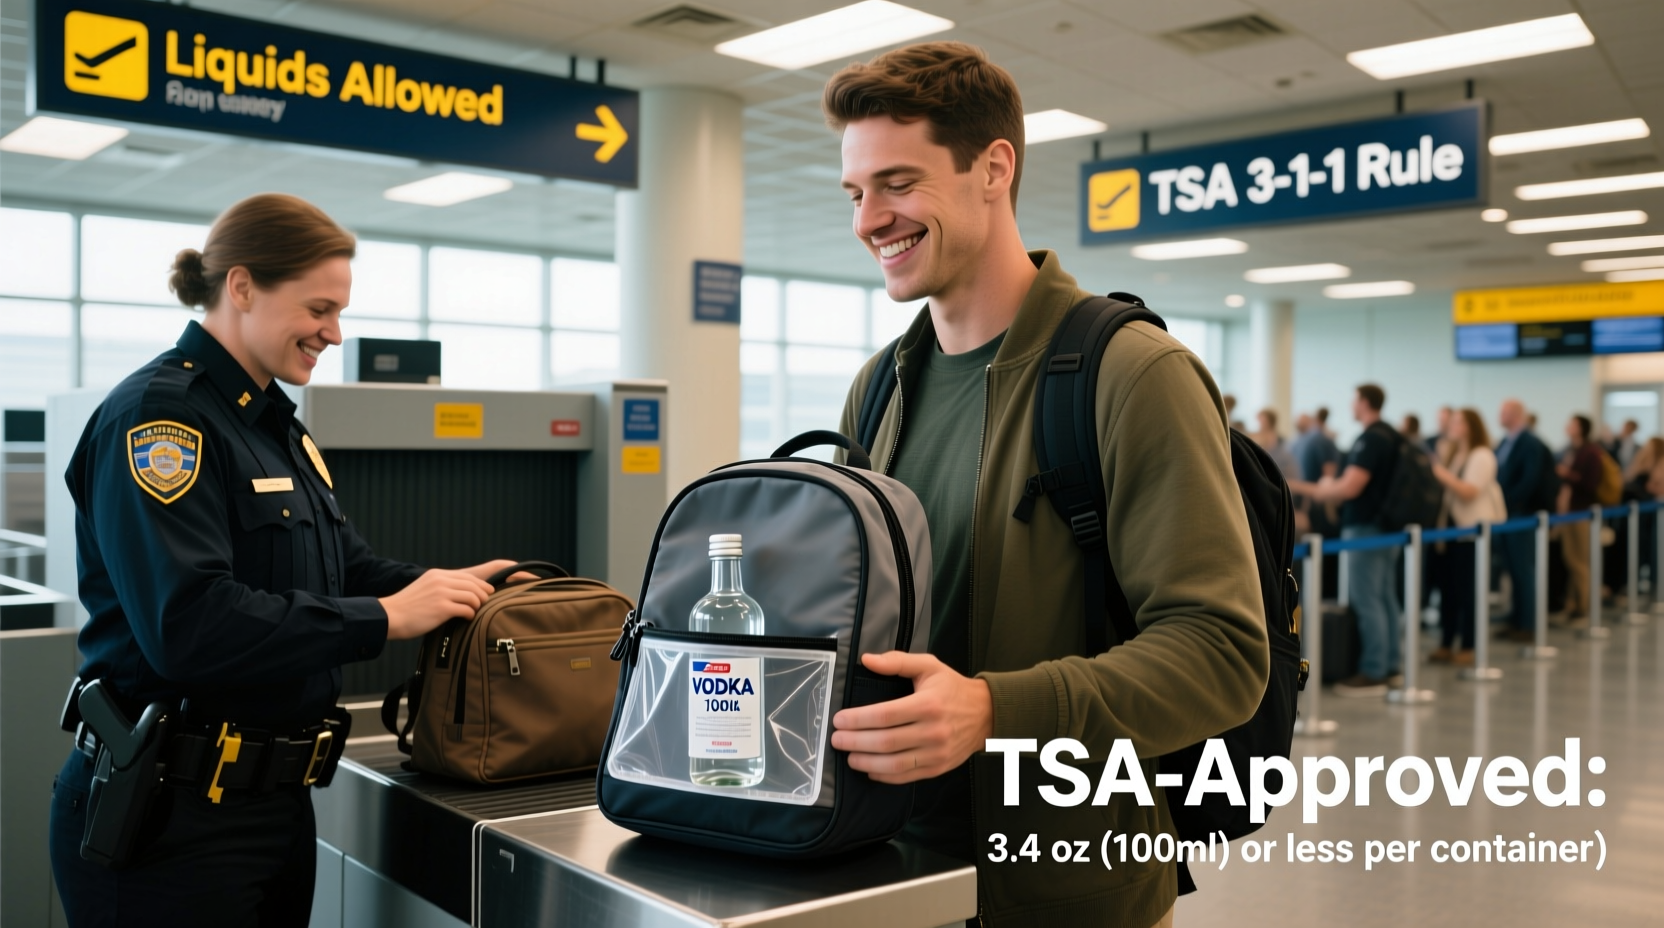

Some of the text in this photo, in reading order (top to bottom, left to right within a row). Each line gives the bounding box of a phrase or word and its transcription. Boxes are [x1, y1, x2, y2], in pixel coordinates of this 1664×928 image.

[166, 30, 331, 98] Liquids
[339, 61, 503, 126] Allowed
[1149, 135, 1464, 215] TSA 3-1-1 Rule
[692, 677, 755, 695] VODKA
